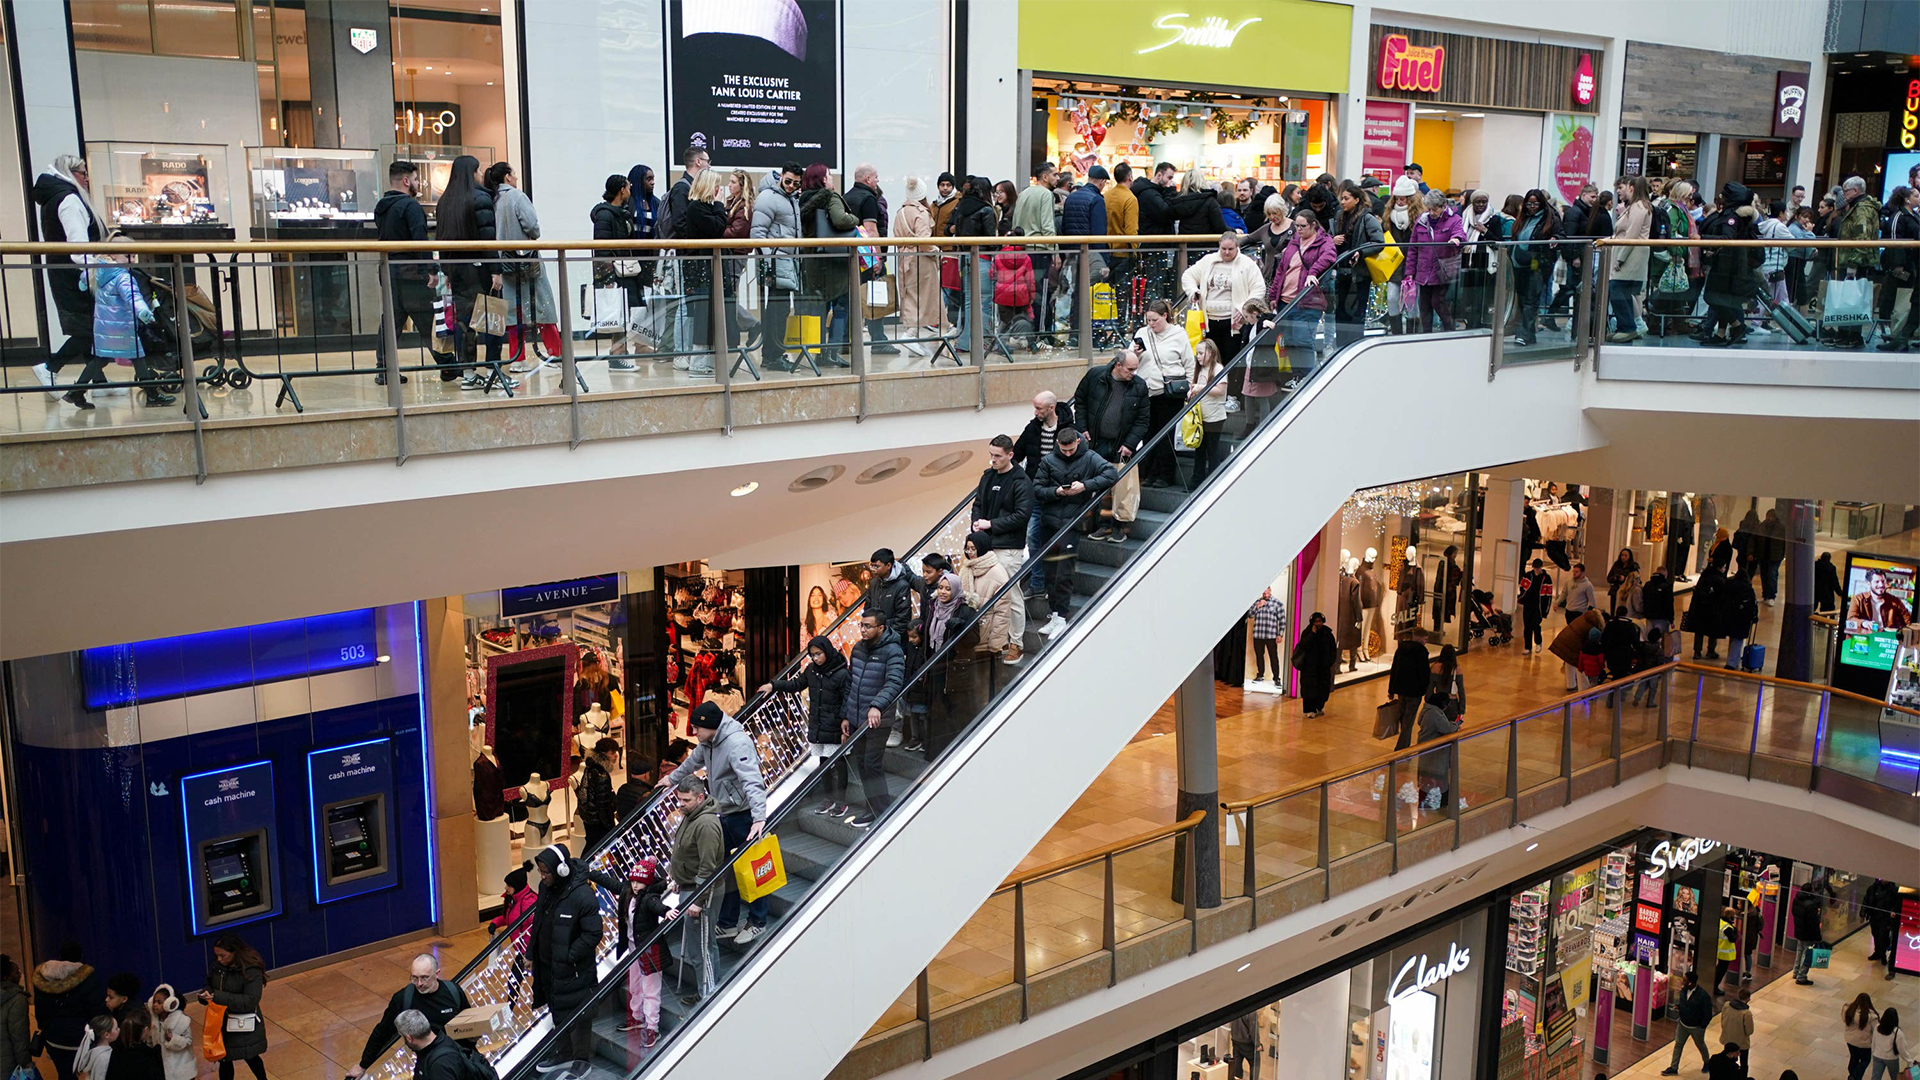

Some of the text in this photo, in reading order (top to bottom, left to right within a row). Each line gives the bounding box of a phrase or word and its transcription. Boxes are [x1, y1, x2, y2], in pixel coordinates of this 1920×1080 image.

[1406, 48, 1420, 57] Juice
[1382, 34, 1445, 92] Fuel
[723, 74, 789, 88] THE EXCLUSIVE
[711, 86, 801, 101] TANK LOUIS CARTIER
[1783, 87, 1803, 97] MUFFIN
[1783, 108, 1799, 117] BREAK
[1824, 313, 1870, 322] BERSHKA
[535, 585, 588, 602] AVENUE
[1390, 607, 1416, 626] SALE
[340, 644, 365, 661] 503
[328, 765, 376, 780] cash machine
[204, 790, 256, 806] cash machine
[756, 859, 773, 879] LEGO
[1643, 878, 1661, 887] BEAUTY
[1555, 890, 1580, 916] SAVE
[1639, 907, 1659, 919] BARBER
[1639, 914, 1658, 924] SHOP
[1565, 935, 1591, 953] REWARDS
[1637, 937, 1655, 948] HAIR
[1388, 941, 1470, 1005] Clarks
